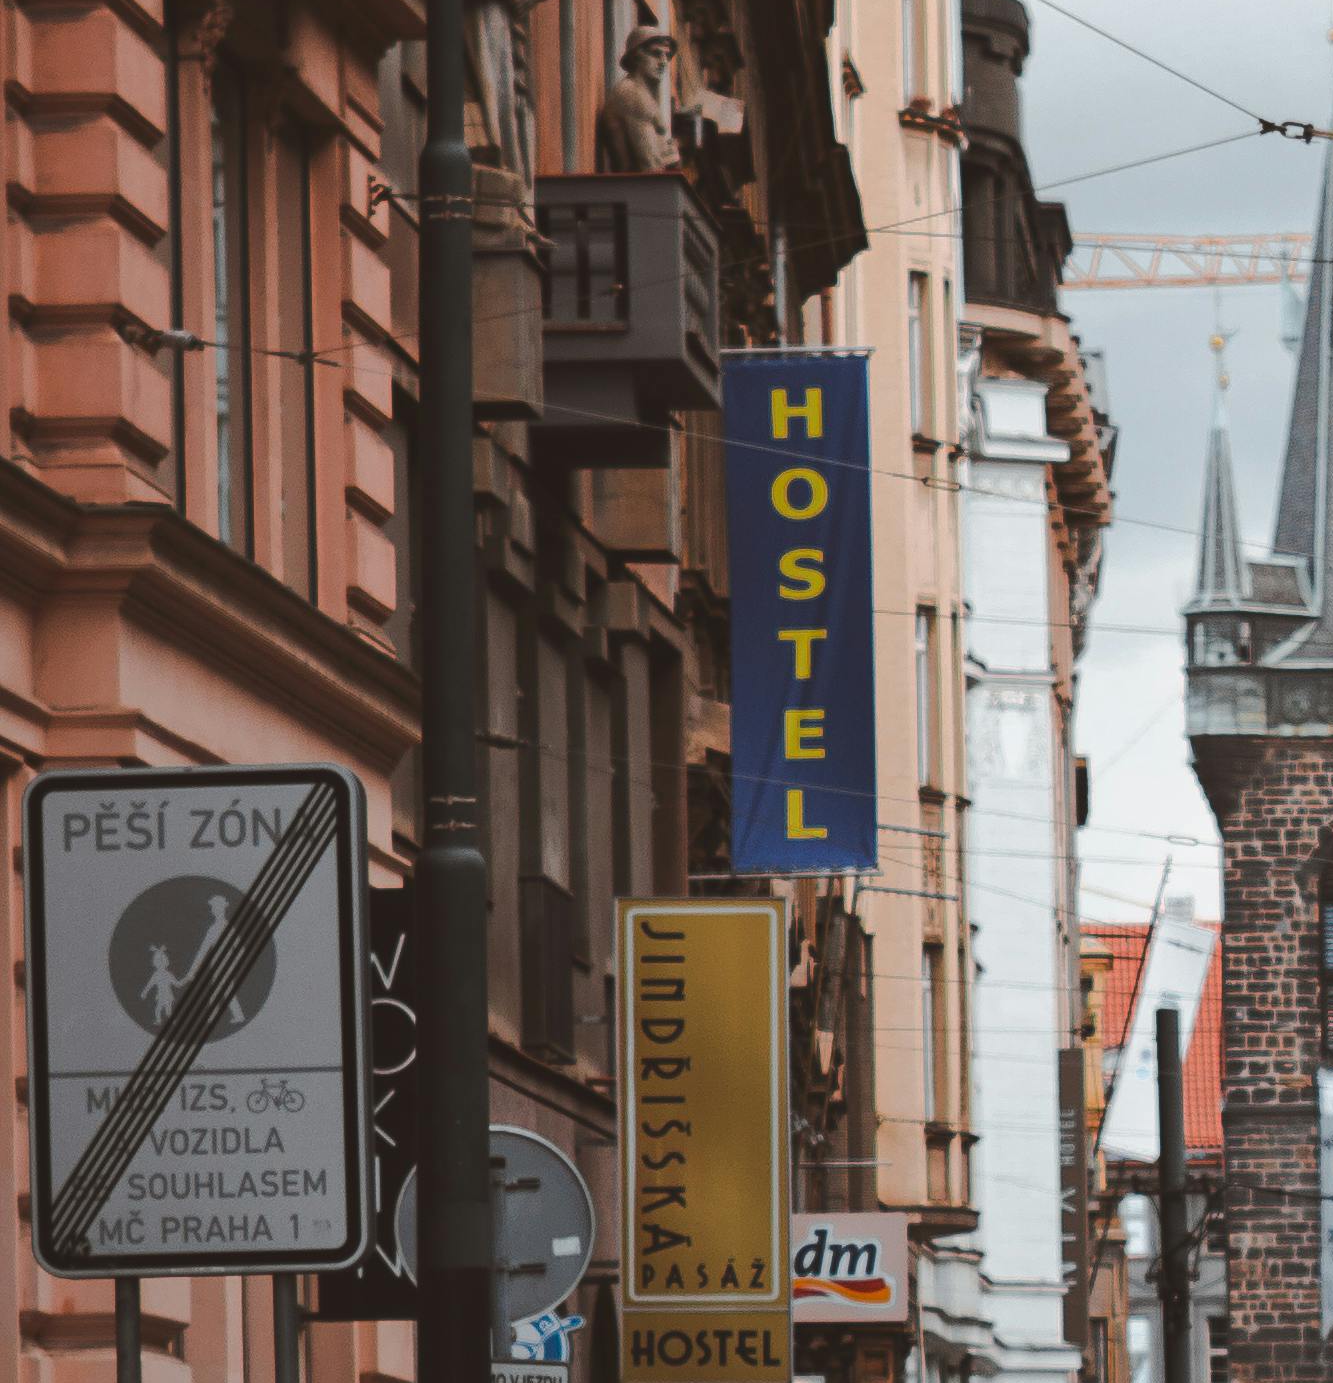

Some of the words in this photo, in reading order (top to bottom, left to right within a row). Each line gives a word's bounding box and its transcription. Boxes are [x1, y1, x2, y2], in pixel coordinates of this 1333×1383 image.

[769, 387, 828, 839] HOSTEL
[63, 799, 170, 852] PĚŠÍ
[188, 799, 300, 849] ZÓN
[640, 921, 692, 1256] JINDŘIŠSKÁ
[150, 1126, 285, 1156] VOZIDLA
[127, 1169, 328, 1201] SOUHLASEM
[99, 1209, 145, 1245] MČ
[160, 1215, 273, 1244] PRAHA
[290, 1213, 300, 1241] 1
[794, 1229, 878, 1278] dm
[641, 1257, 766, 1290] PASÁŽ
[631, 1329, 781, 1368] HOSTEL
